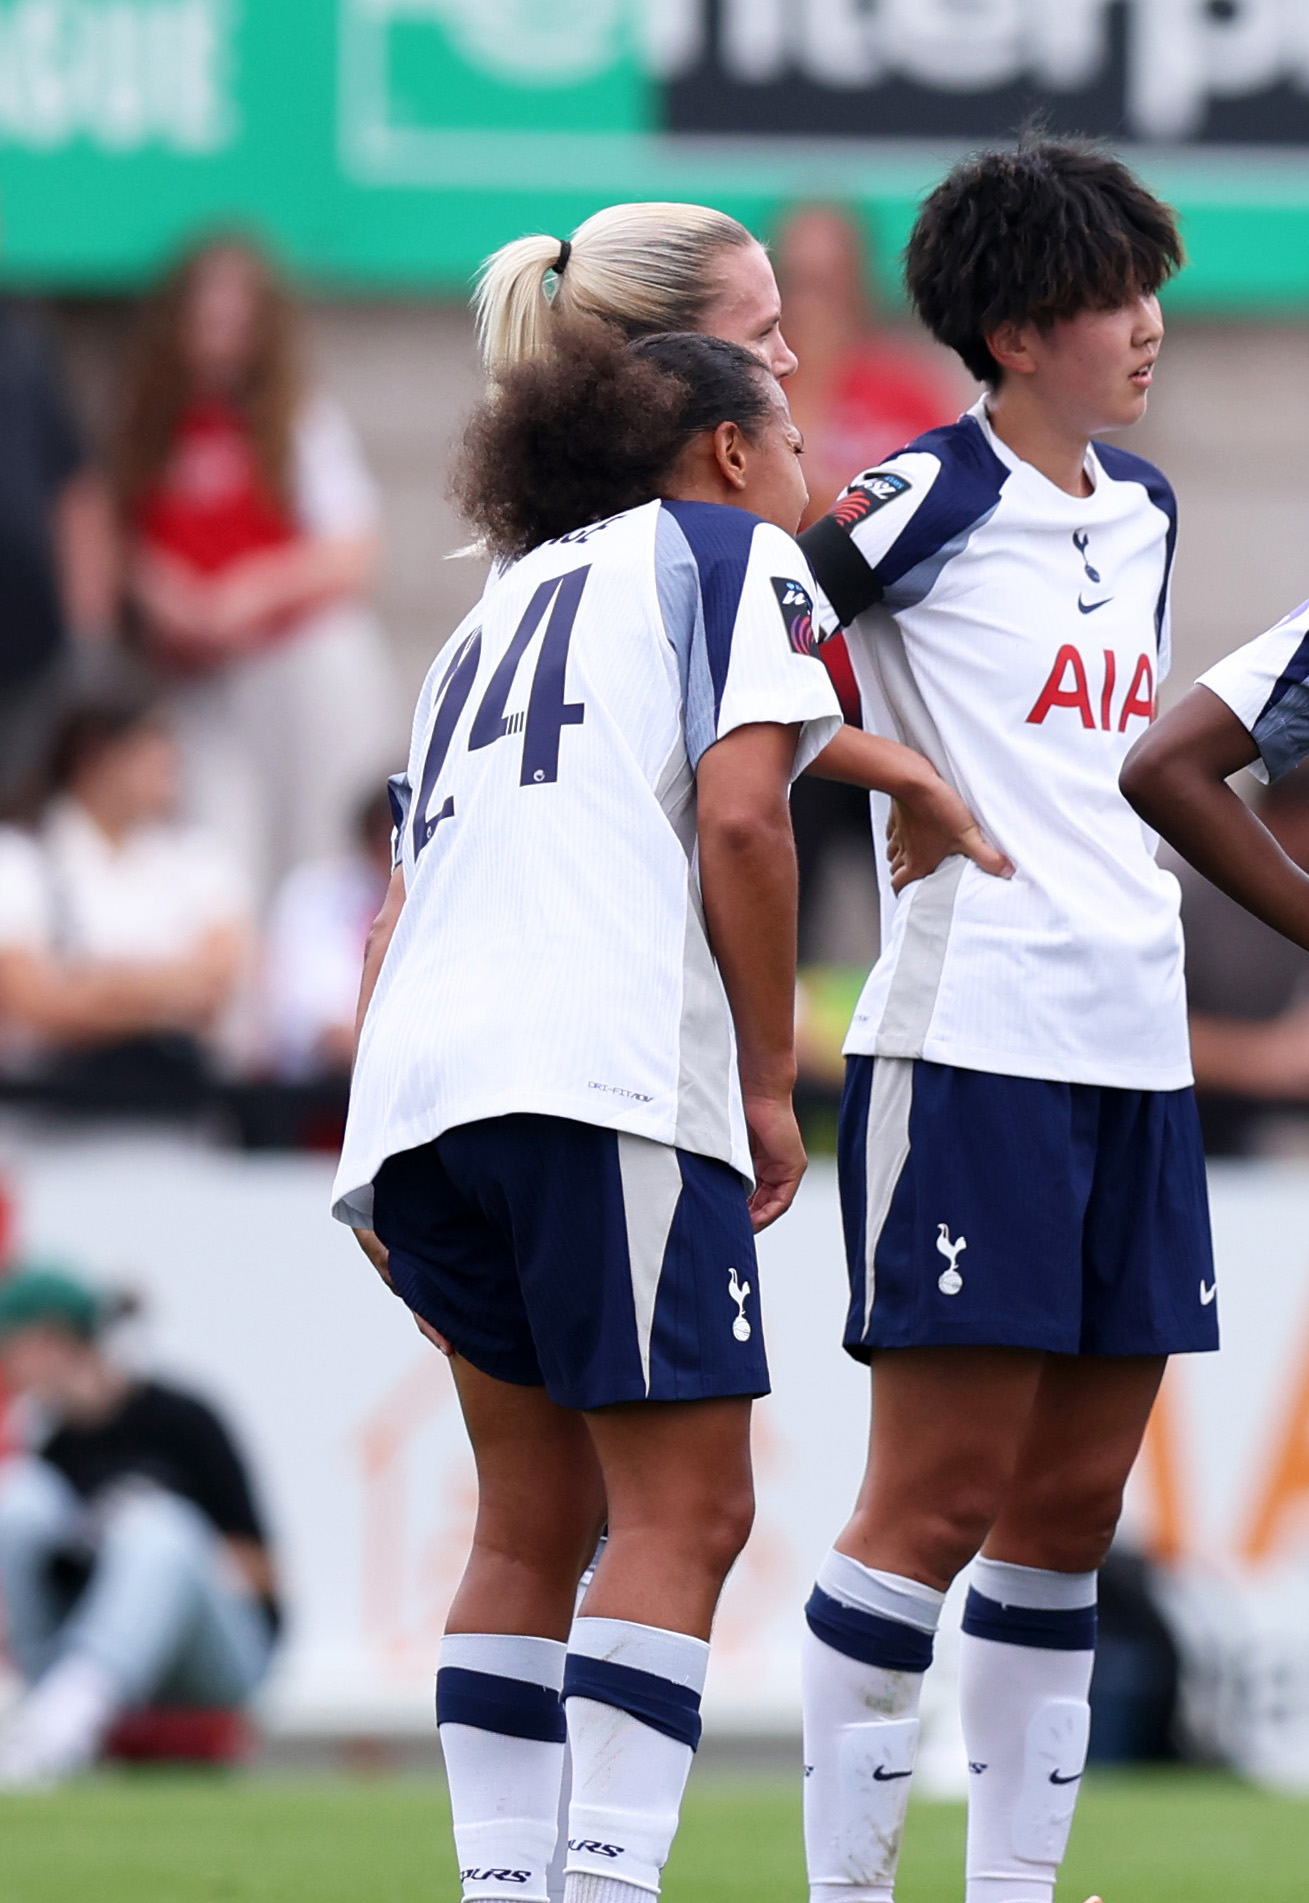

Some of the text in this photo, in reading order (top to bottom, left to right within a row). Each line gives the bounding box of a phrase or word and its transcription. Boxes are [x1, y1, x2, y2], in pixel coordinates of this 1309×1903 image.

[412, 563, 586, 864] 24
[1025, 644, 1153, 733] AIA
[460, 1867, 532, 1883] PURS
